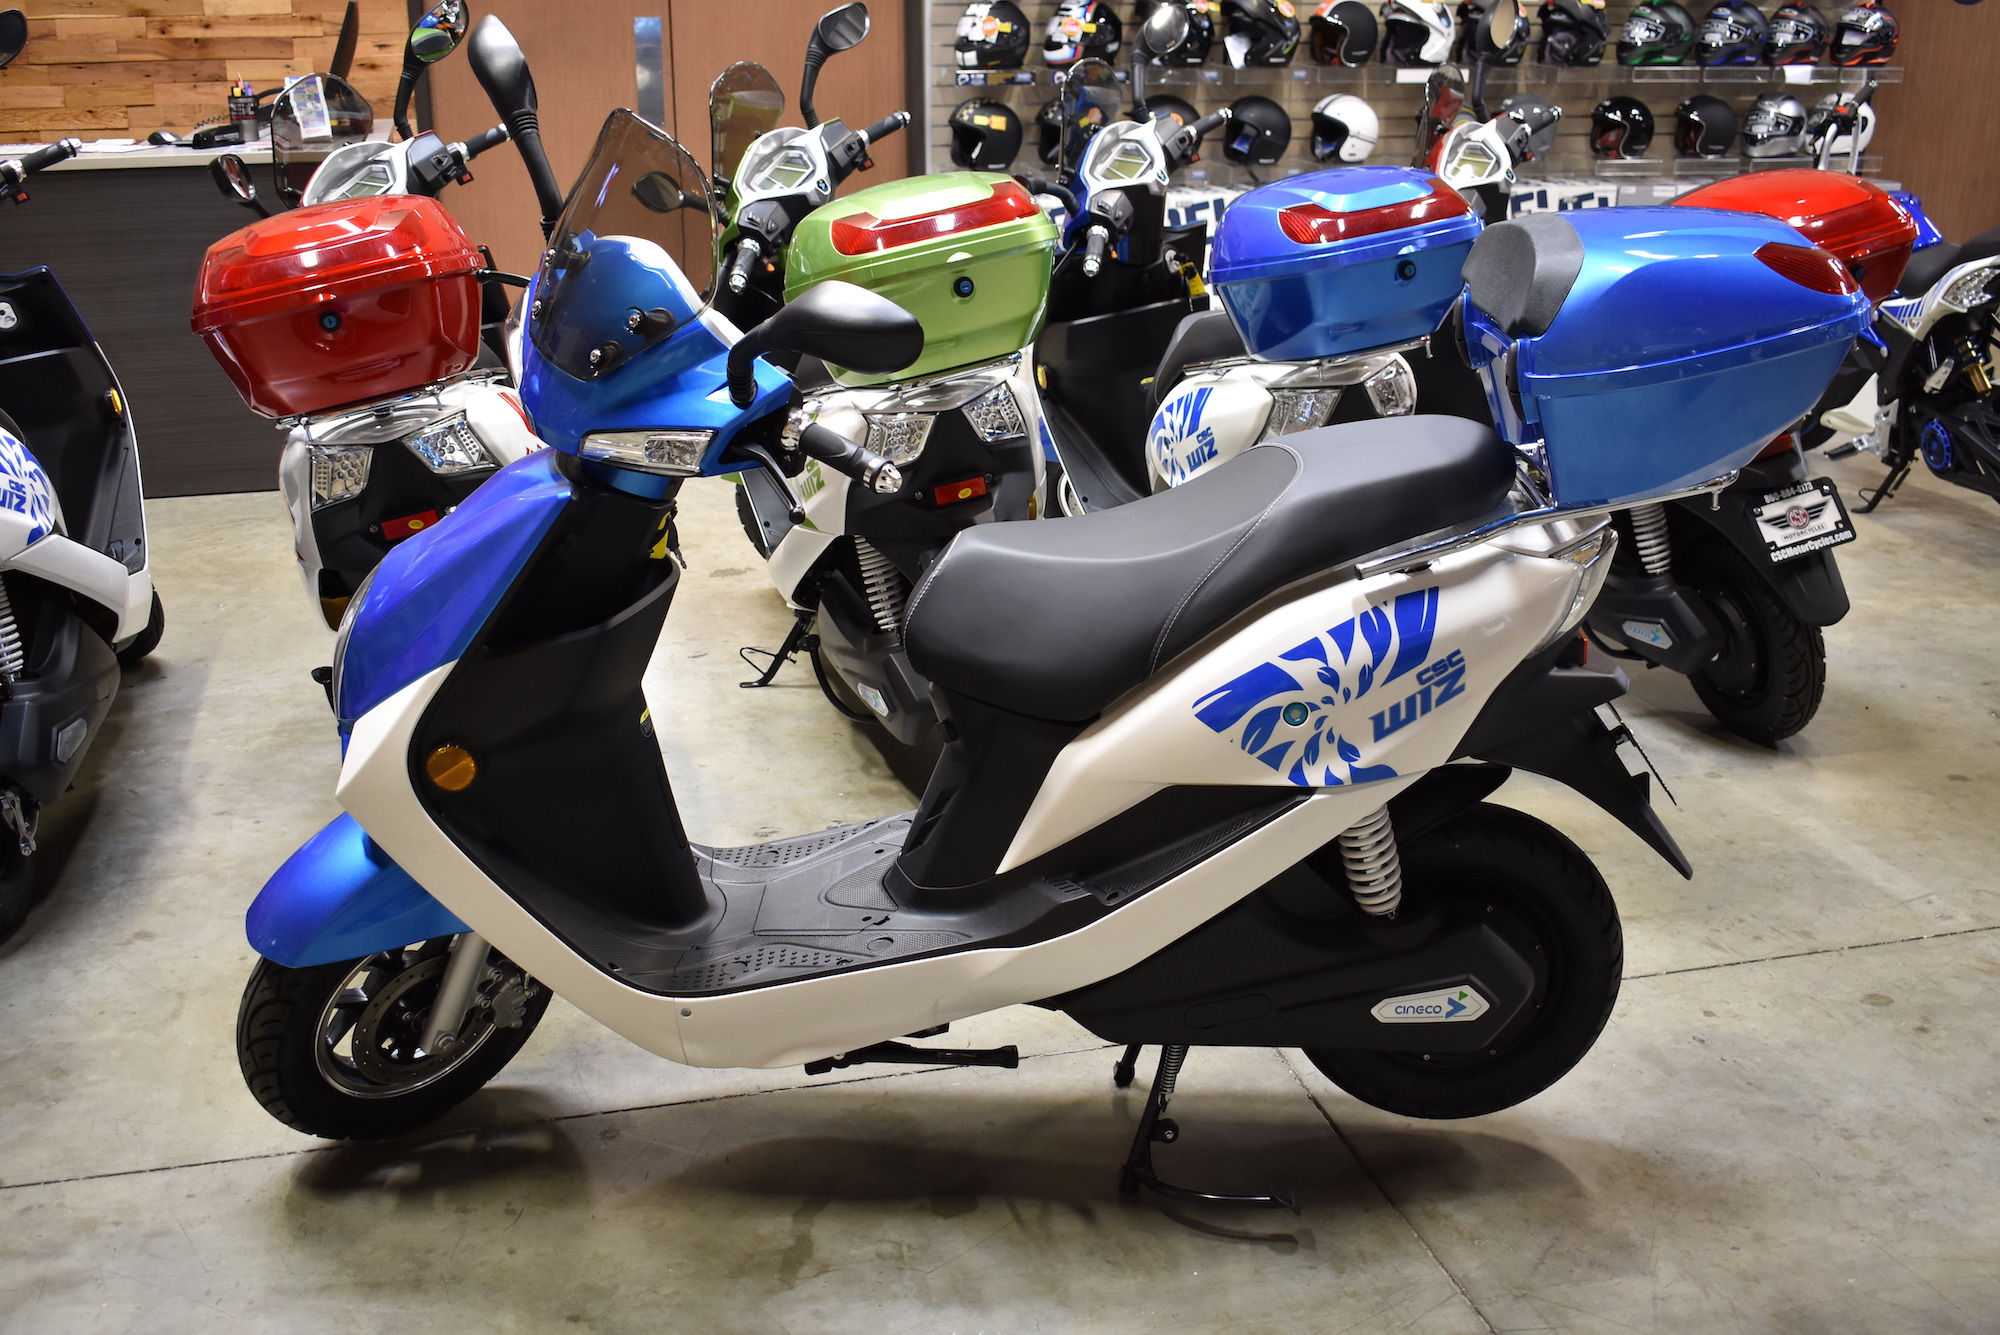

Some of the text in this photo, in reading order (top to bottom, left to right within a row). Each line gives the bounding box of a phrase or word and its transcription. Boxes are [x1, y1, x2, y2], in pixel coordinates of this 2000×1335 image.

[1196, 426, 1214, 444] CSC
[1186, 436, 1218, 473] WIZ
[800, 466, 826, 503] WIZ
[1783, 524, 1826, 541] MOTORCYCLES
[1788, 508, 1808, 526] CSC
[1770, 529, 1854, 562] CSCMotorCycles.com
[1415, 648, 1465, 686] CSC
[1367, 663, 1466, 744] WIZ
